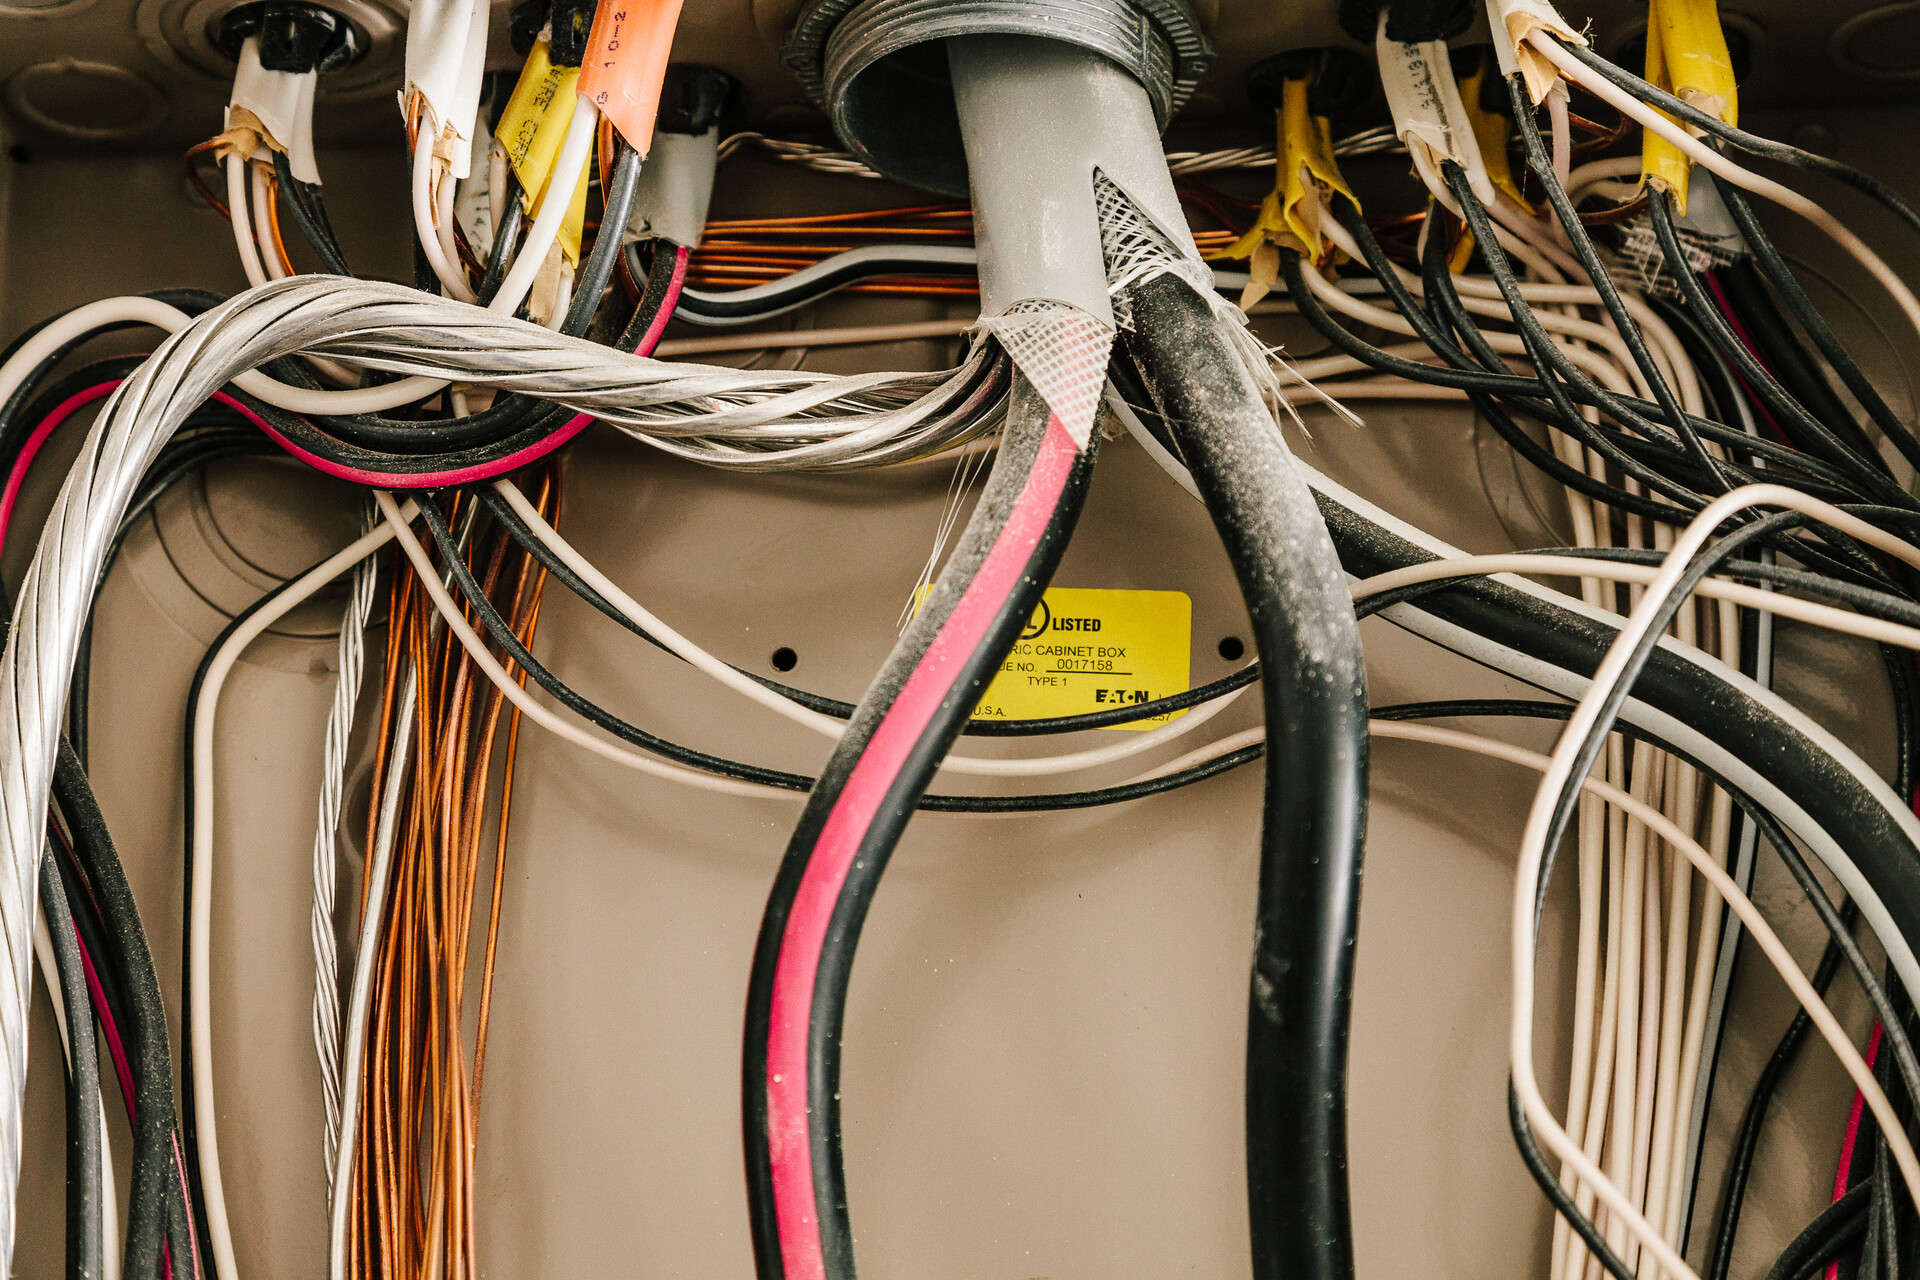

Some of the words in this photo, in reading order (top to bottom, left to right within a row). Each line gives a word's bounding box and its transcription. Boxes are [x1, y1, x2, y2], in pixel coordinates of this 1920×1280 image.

[1053, 617, 1102, 632] LISTED
[1010, 644, 1032, 655] RIC
[1035, 644, 1095, 657] CABINET
[1097, 647, 1127, 658] BOX
[1000, 661, 1014, 671] UE
[1016, 662, 1038, 673] NO.
[1057, 658, 1113, 671] 0017158
[1027, 676, 1059, 687] TYPE
[1062, 677, 1068, 687] 1
